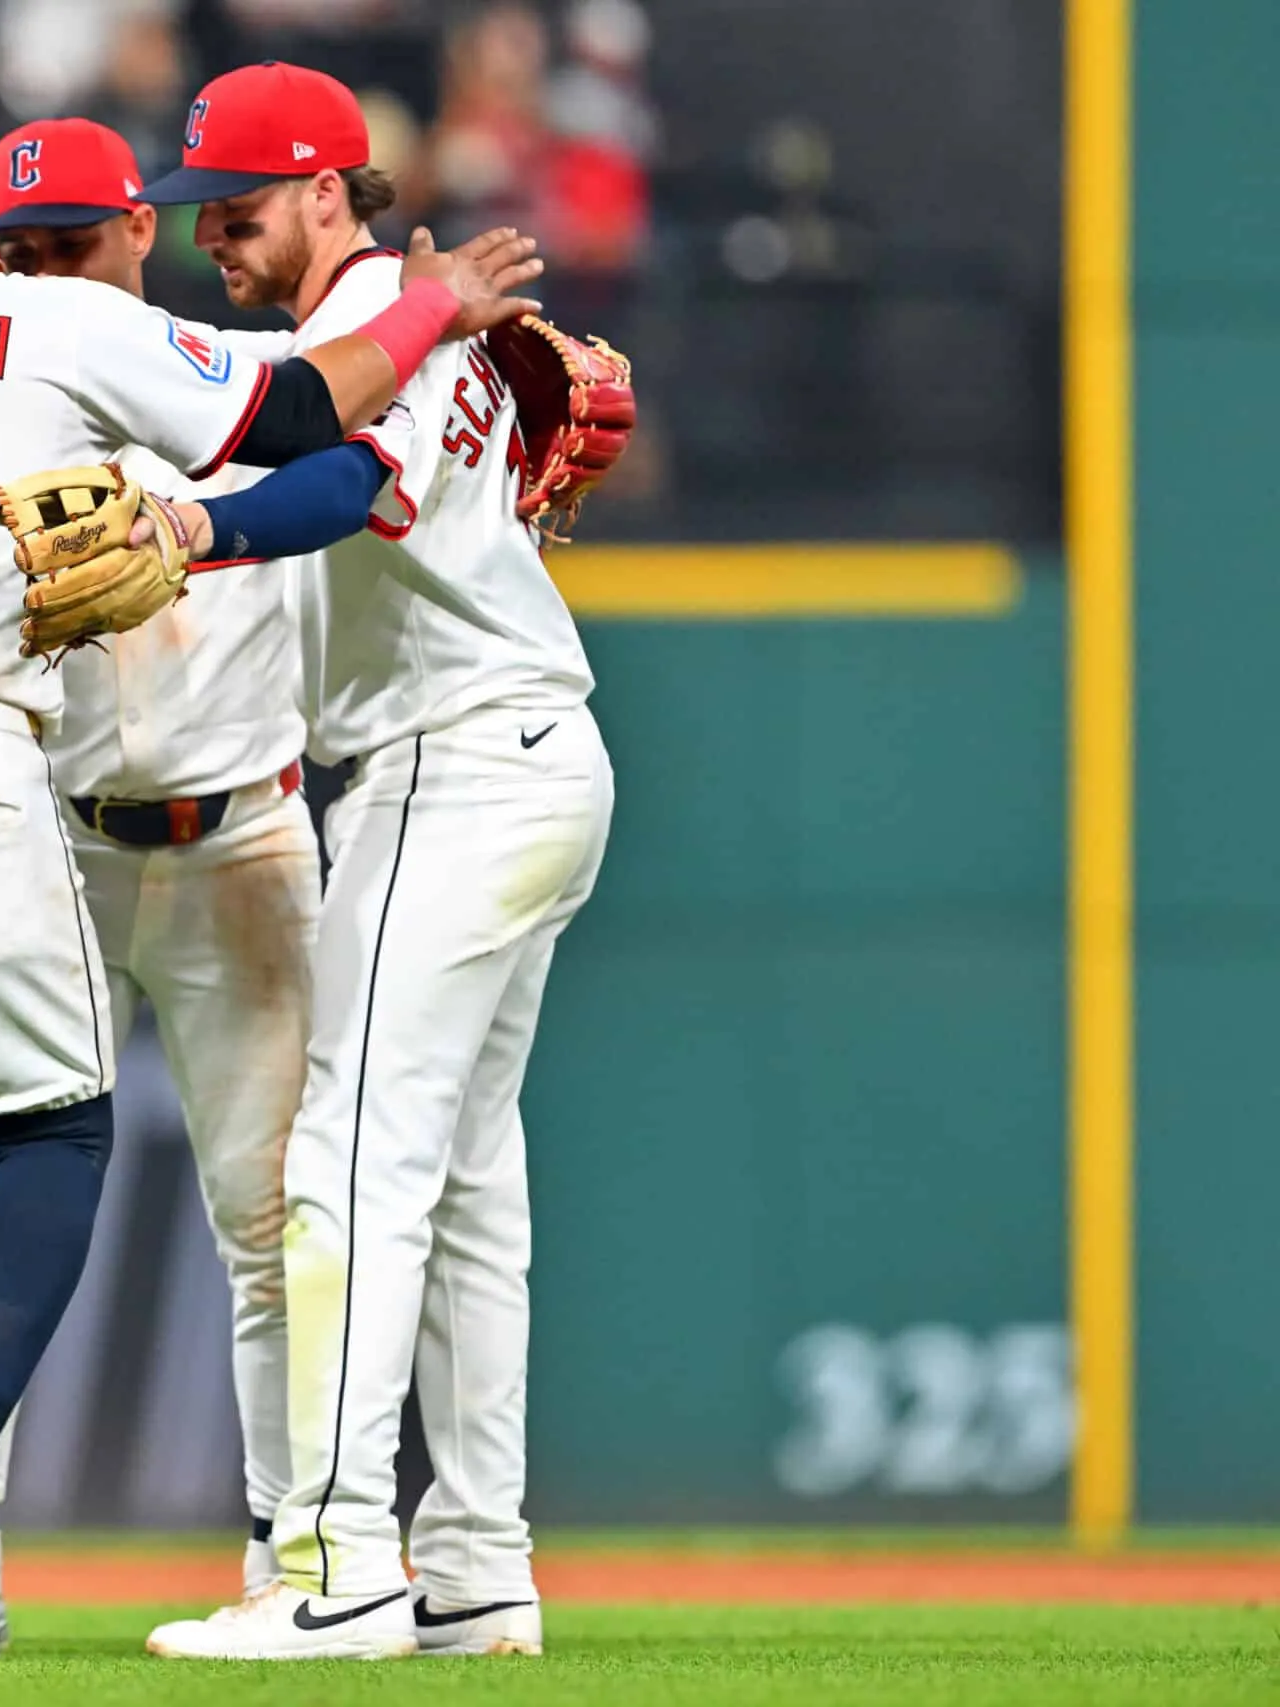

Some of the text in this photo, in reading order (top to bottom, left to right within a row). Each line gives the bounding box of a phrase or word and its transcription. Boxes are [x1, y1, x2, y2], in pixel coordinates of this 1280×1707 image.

[185, 99, 208, 150] C
[10, 139, 42, 191] C
[442, 335, 505, 468] SCH
[52, 522, 107, 556] Rawlings
[774, 1321, 1078, 1494] 325
